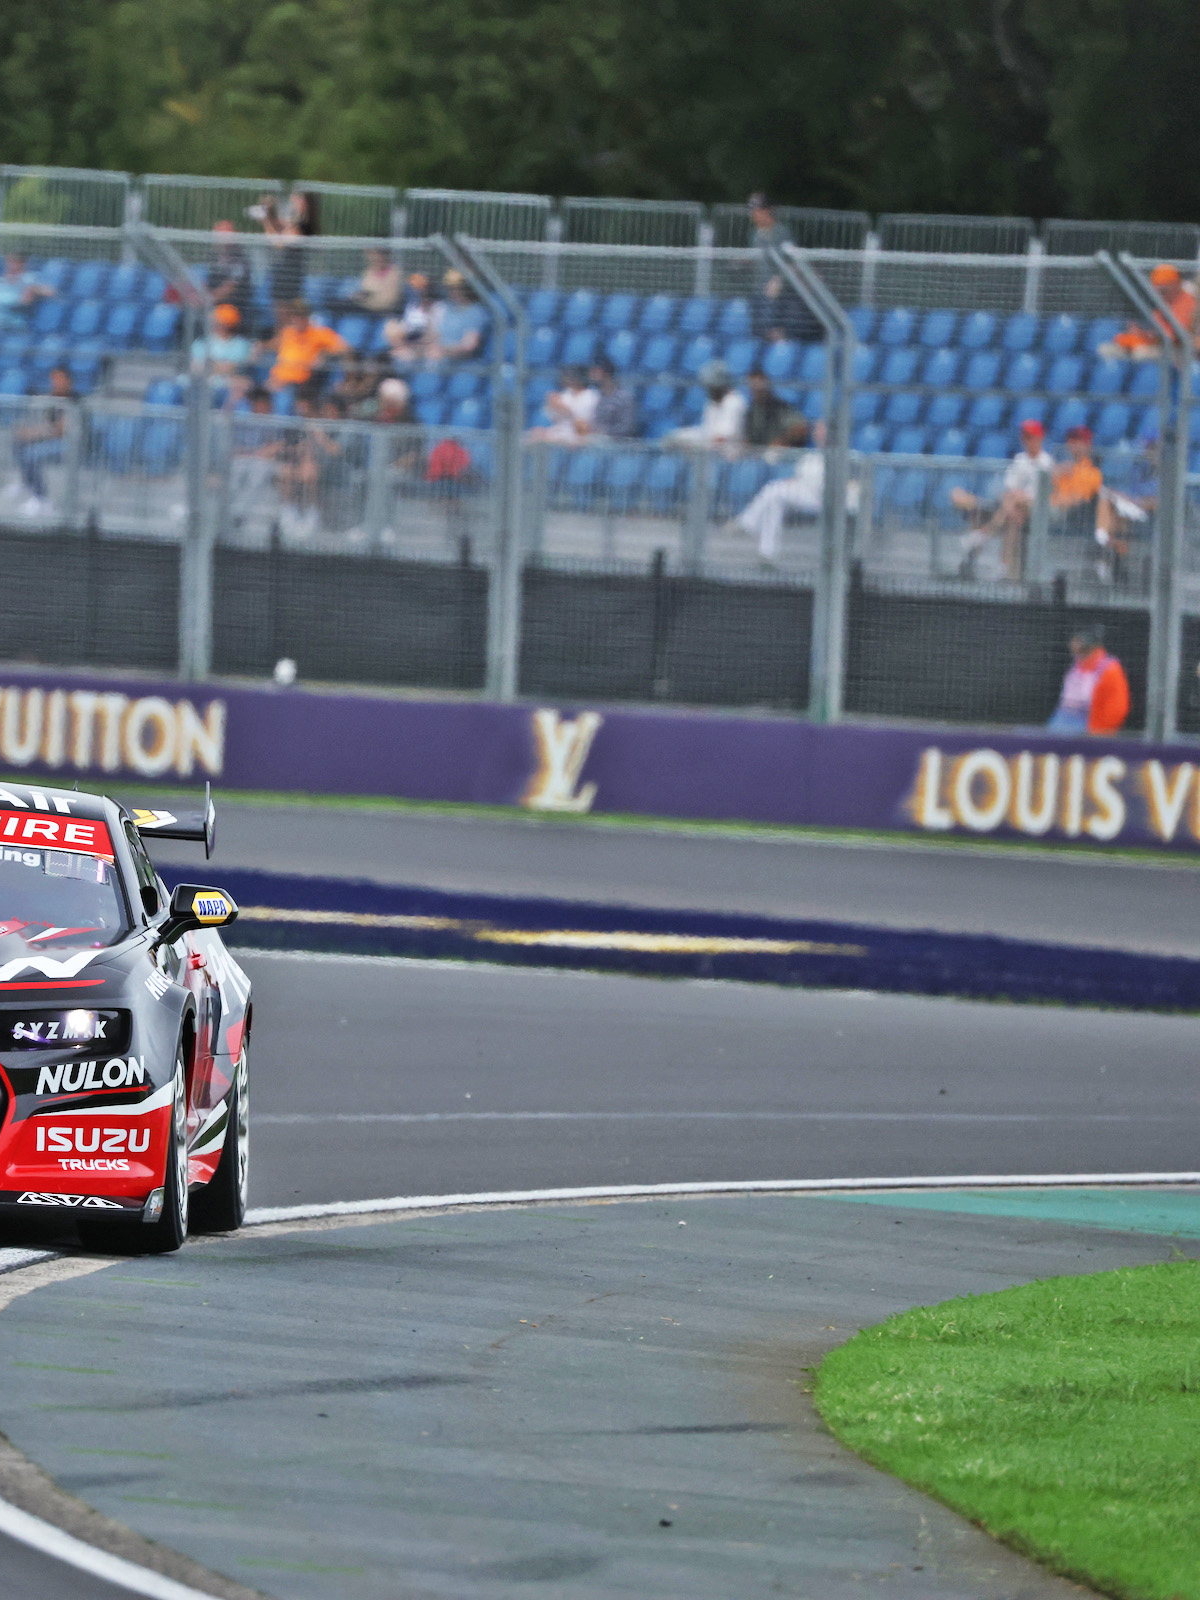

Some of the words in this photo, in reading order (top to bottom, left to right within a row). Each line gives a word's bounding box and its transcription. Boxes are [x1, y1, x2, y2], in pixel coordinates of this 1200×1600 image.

[912, 746, 1126, 841] LOUIS
[198, 900, 227, 916] NAPA
[35, 1055, 145, 1095] NULON
[36, 1126, 150, 1153] ISUZU
[58, 1158, 130, 1171] TRUCKS
